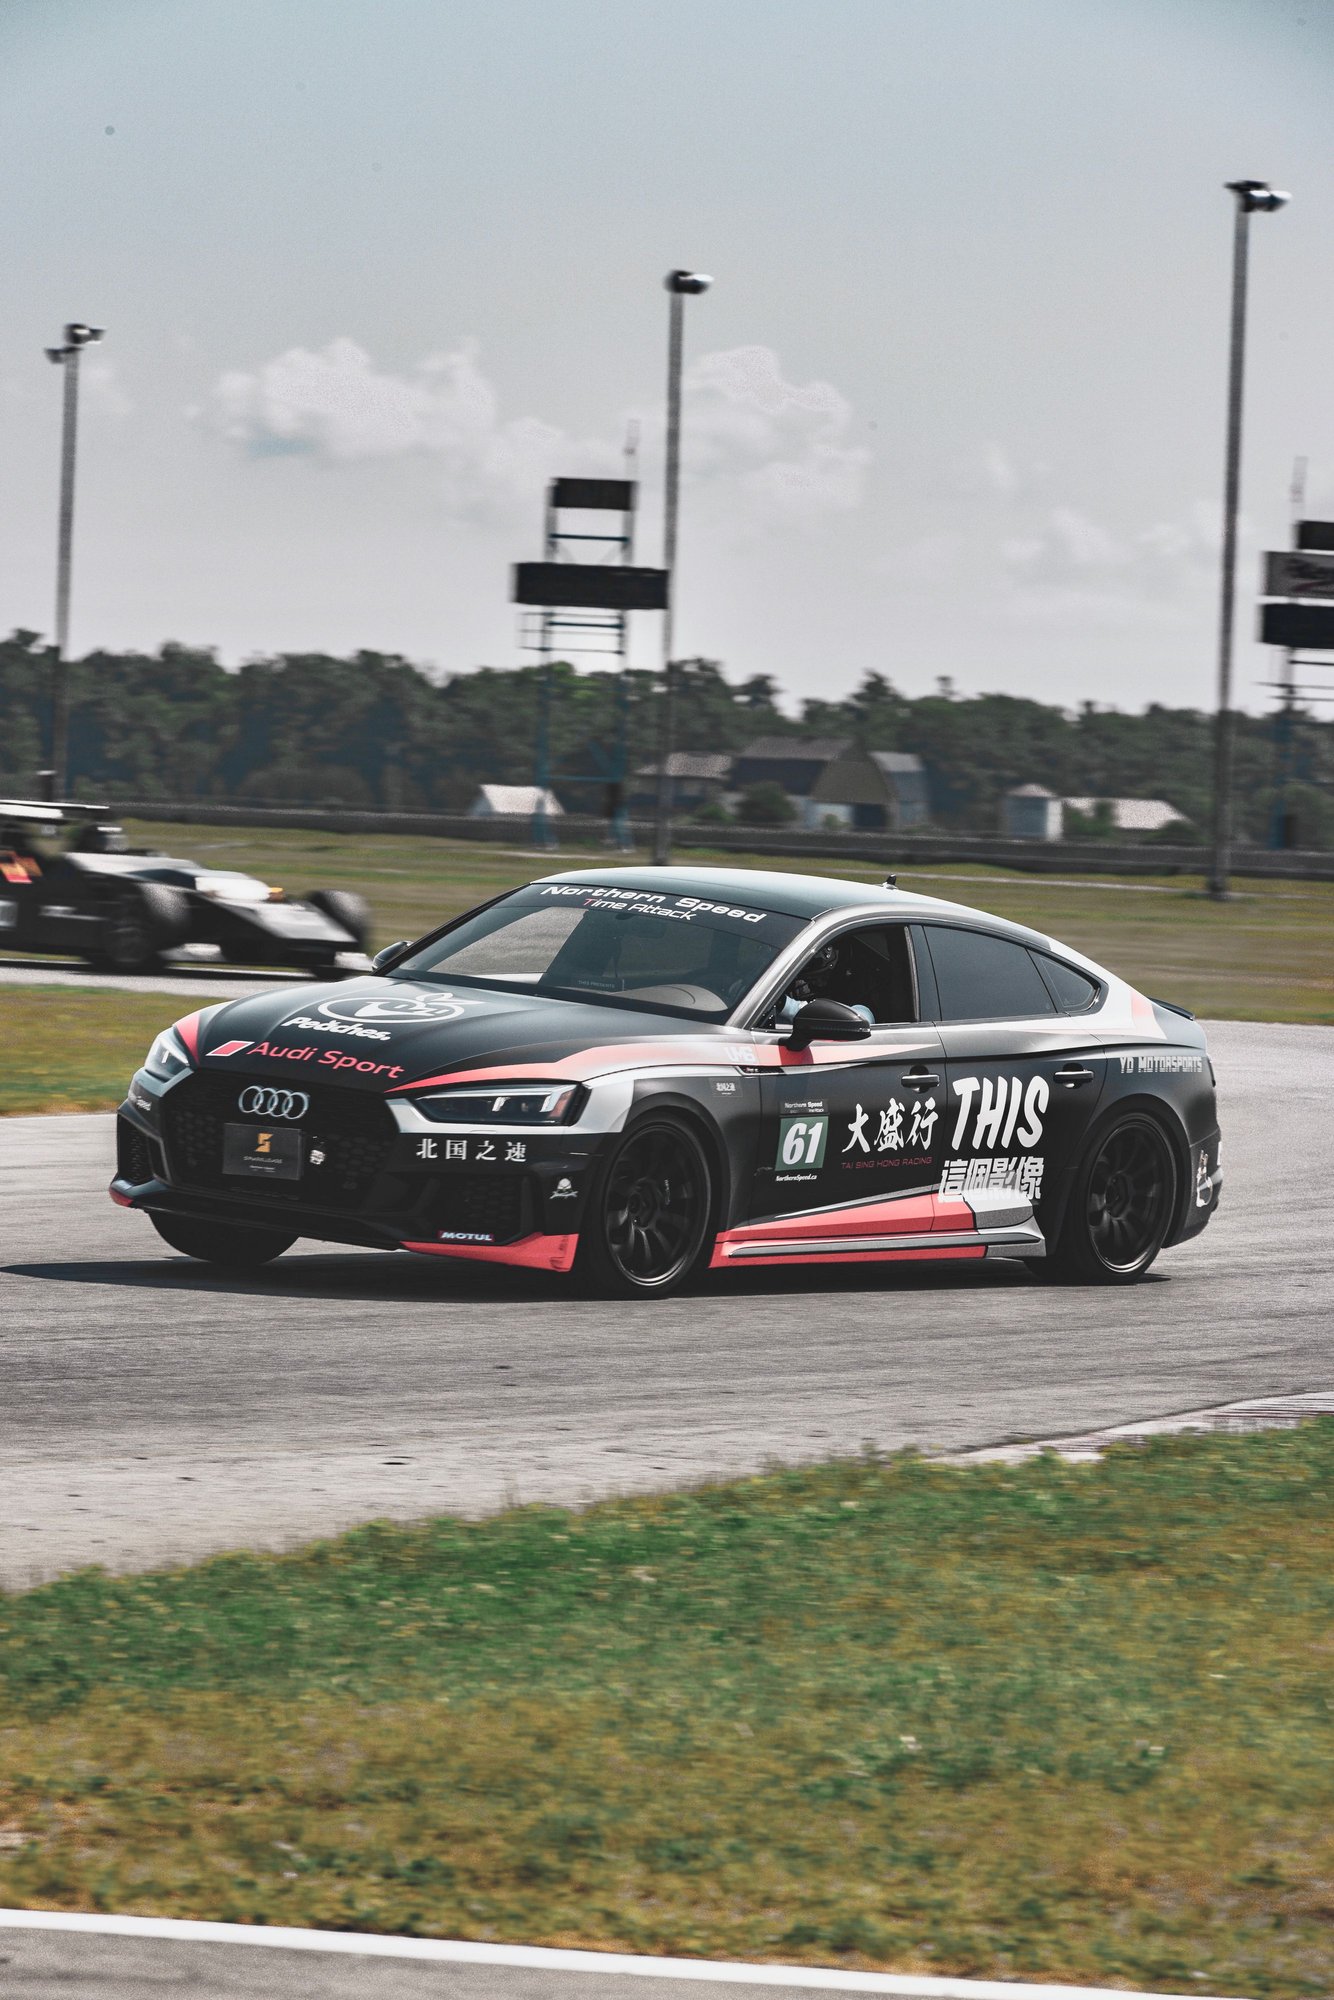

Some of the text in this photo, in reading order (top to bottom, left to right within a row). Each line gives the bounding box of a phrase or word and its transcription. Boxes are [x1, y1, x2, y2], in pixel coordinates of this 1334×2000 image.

[540, 886, 767, 923] Northern Speed
[583, 898, 697, 921] Time Attack
[246, 1041, 405, 1079] Audi Sport
[1138, 1056, 1202, 1073] MOTORSPORTS
[952, 1075, 1049, 1150] THIS
[416, 1138, 526, 1162] 北国之速
[782, 1122, 823, 1165] 61
[855, 1160, 875, 1169] SING
[876, 1159, 900, 1167] HONG
[902, 1157, 932, 1165] RACING
[441, 1231, 492, 1241] MOTUL
